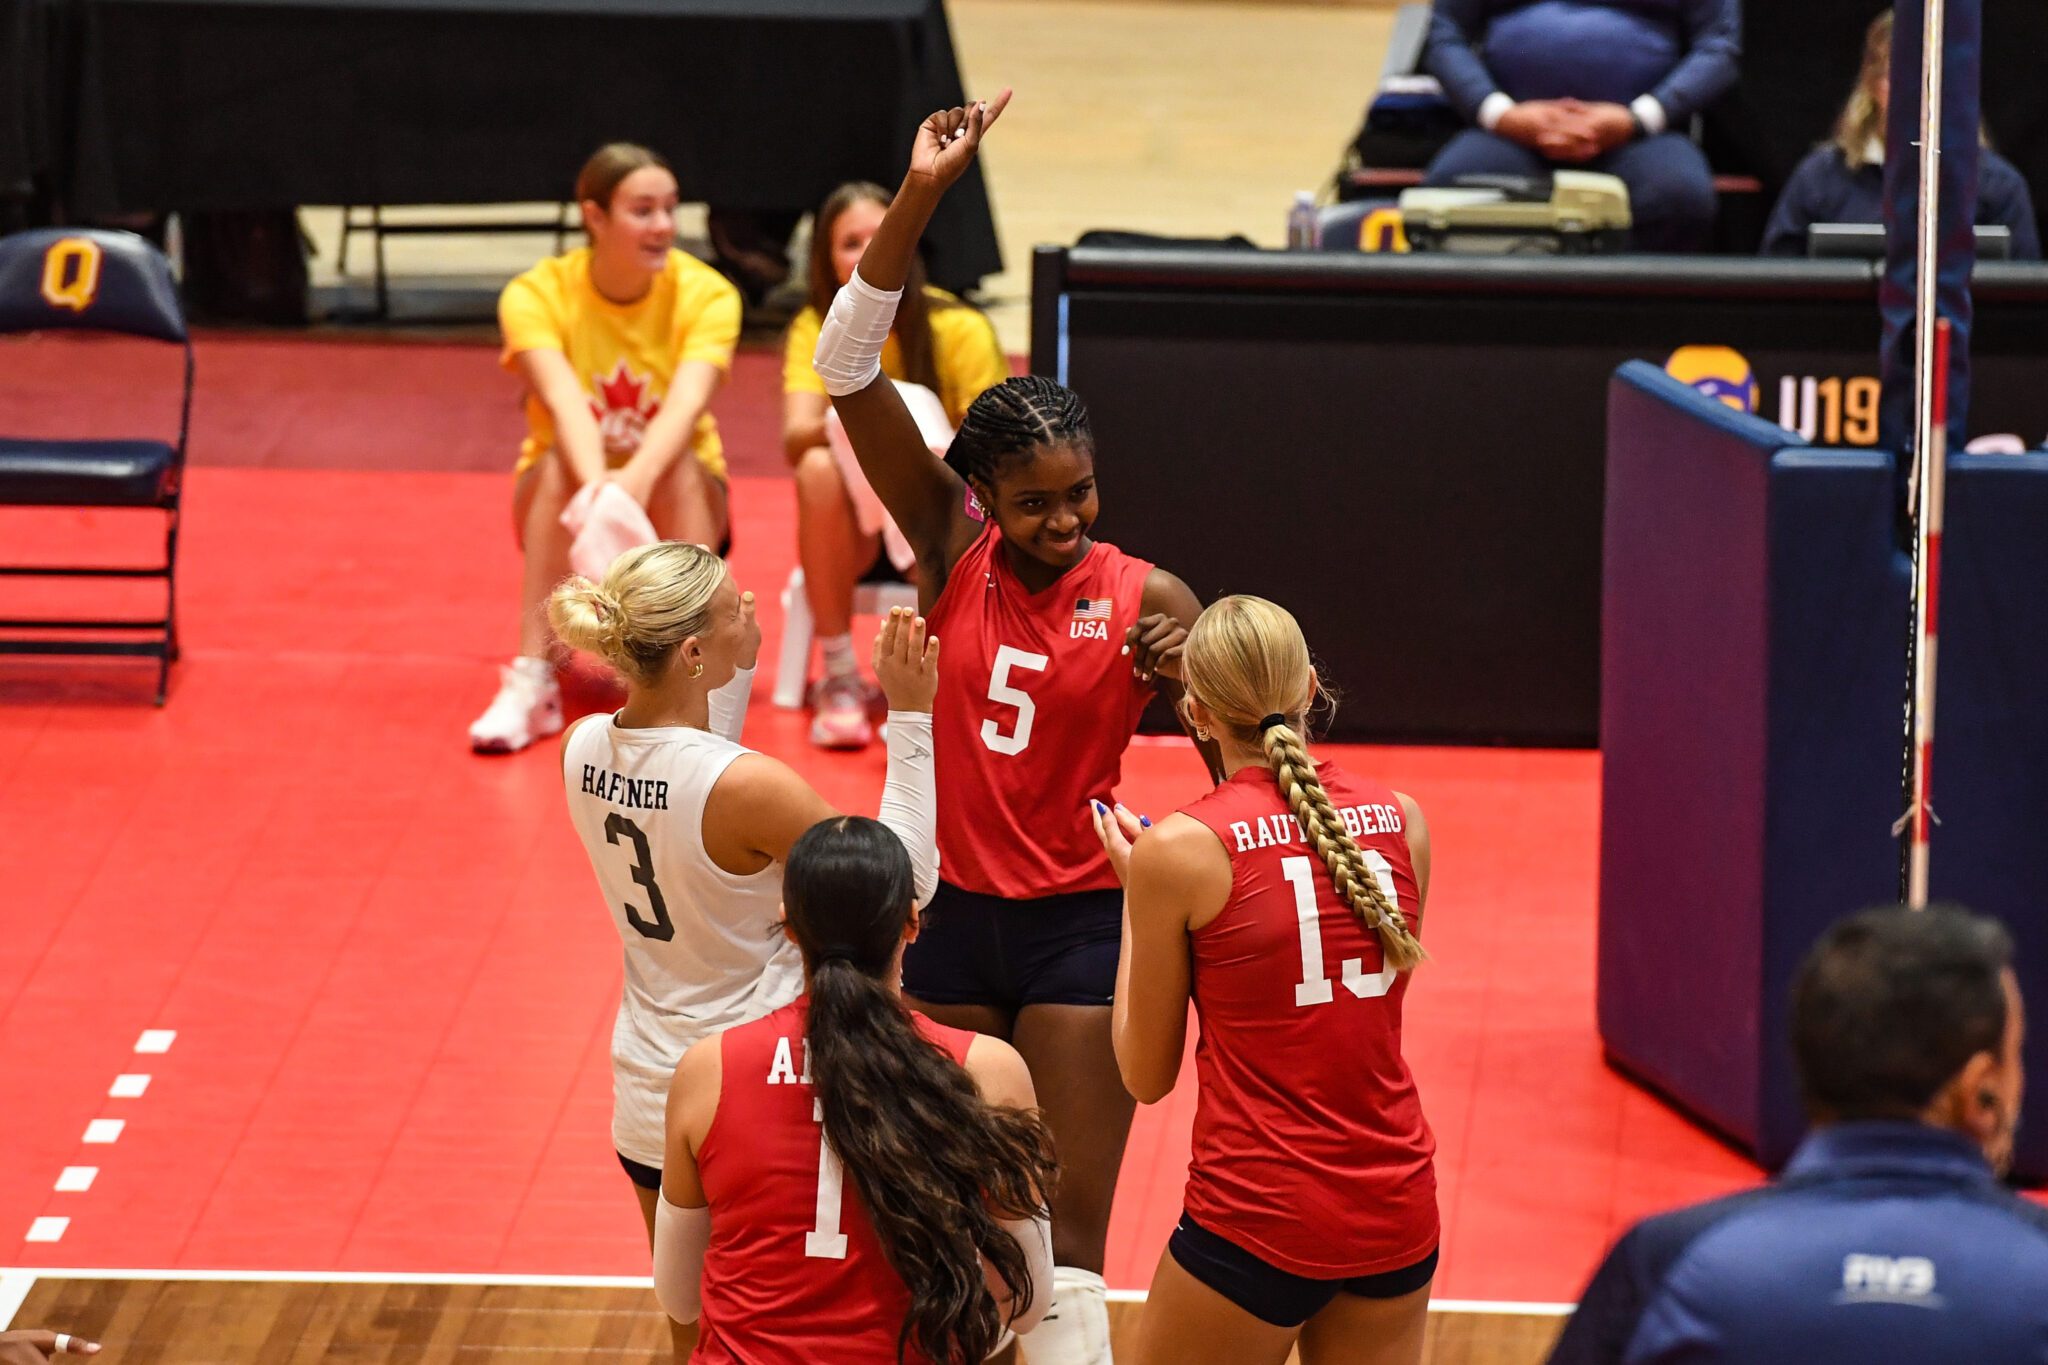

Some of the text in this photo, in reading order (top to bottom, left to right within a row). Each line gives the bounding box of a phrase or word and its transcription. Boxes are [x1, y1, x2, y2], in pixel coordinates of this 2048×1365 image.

[41, 237, 101, 312] Q
[1779, 375, 1881, 445] U19
[1069, 621, 1109, 641] USA
[980, 644, 1049, 757] 5
[604, 812, 675, 943] 3
[804, 1097, 848, 1260] 1
